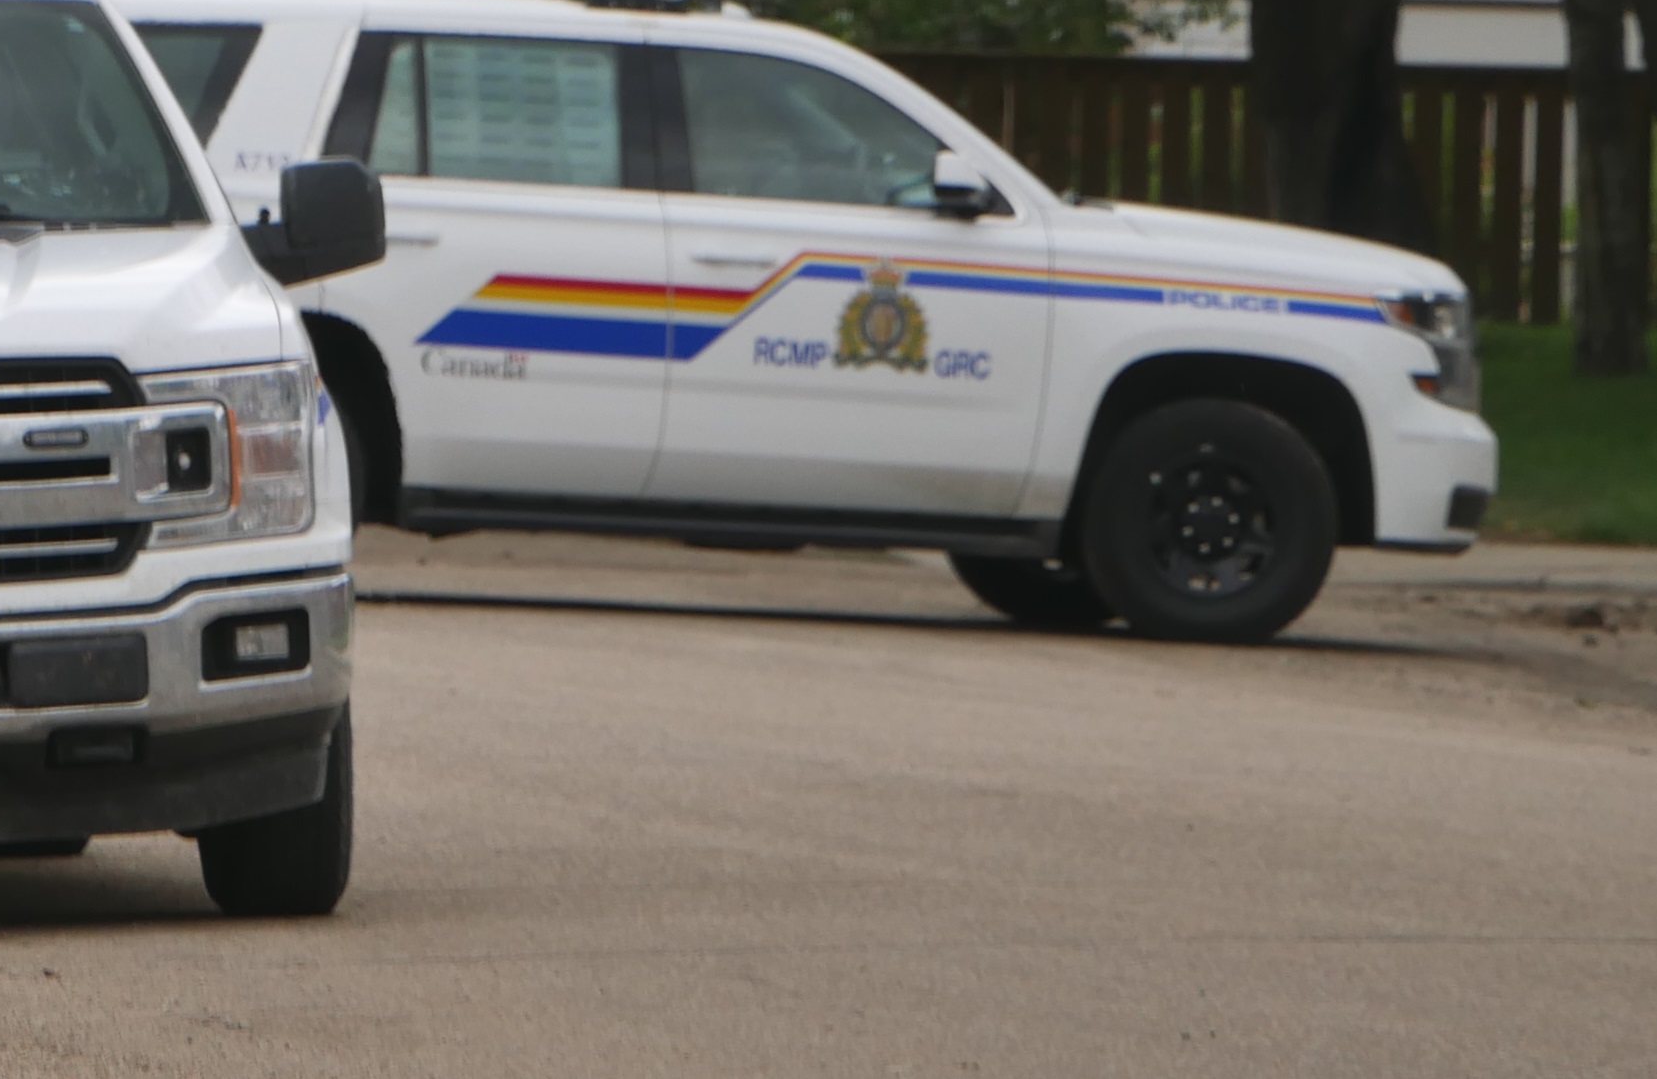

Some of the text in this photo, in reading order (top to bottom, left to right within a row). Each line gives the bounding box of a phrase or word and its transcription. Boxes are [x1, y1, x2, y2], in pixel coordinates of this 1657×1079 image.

[1167, 288, 1280, 314] POLICE
[420, 346, 526, 380] Canada
[753, 336, 991, 380] RCMP GRC
